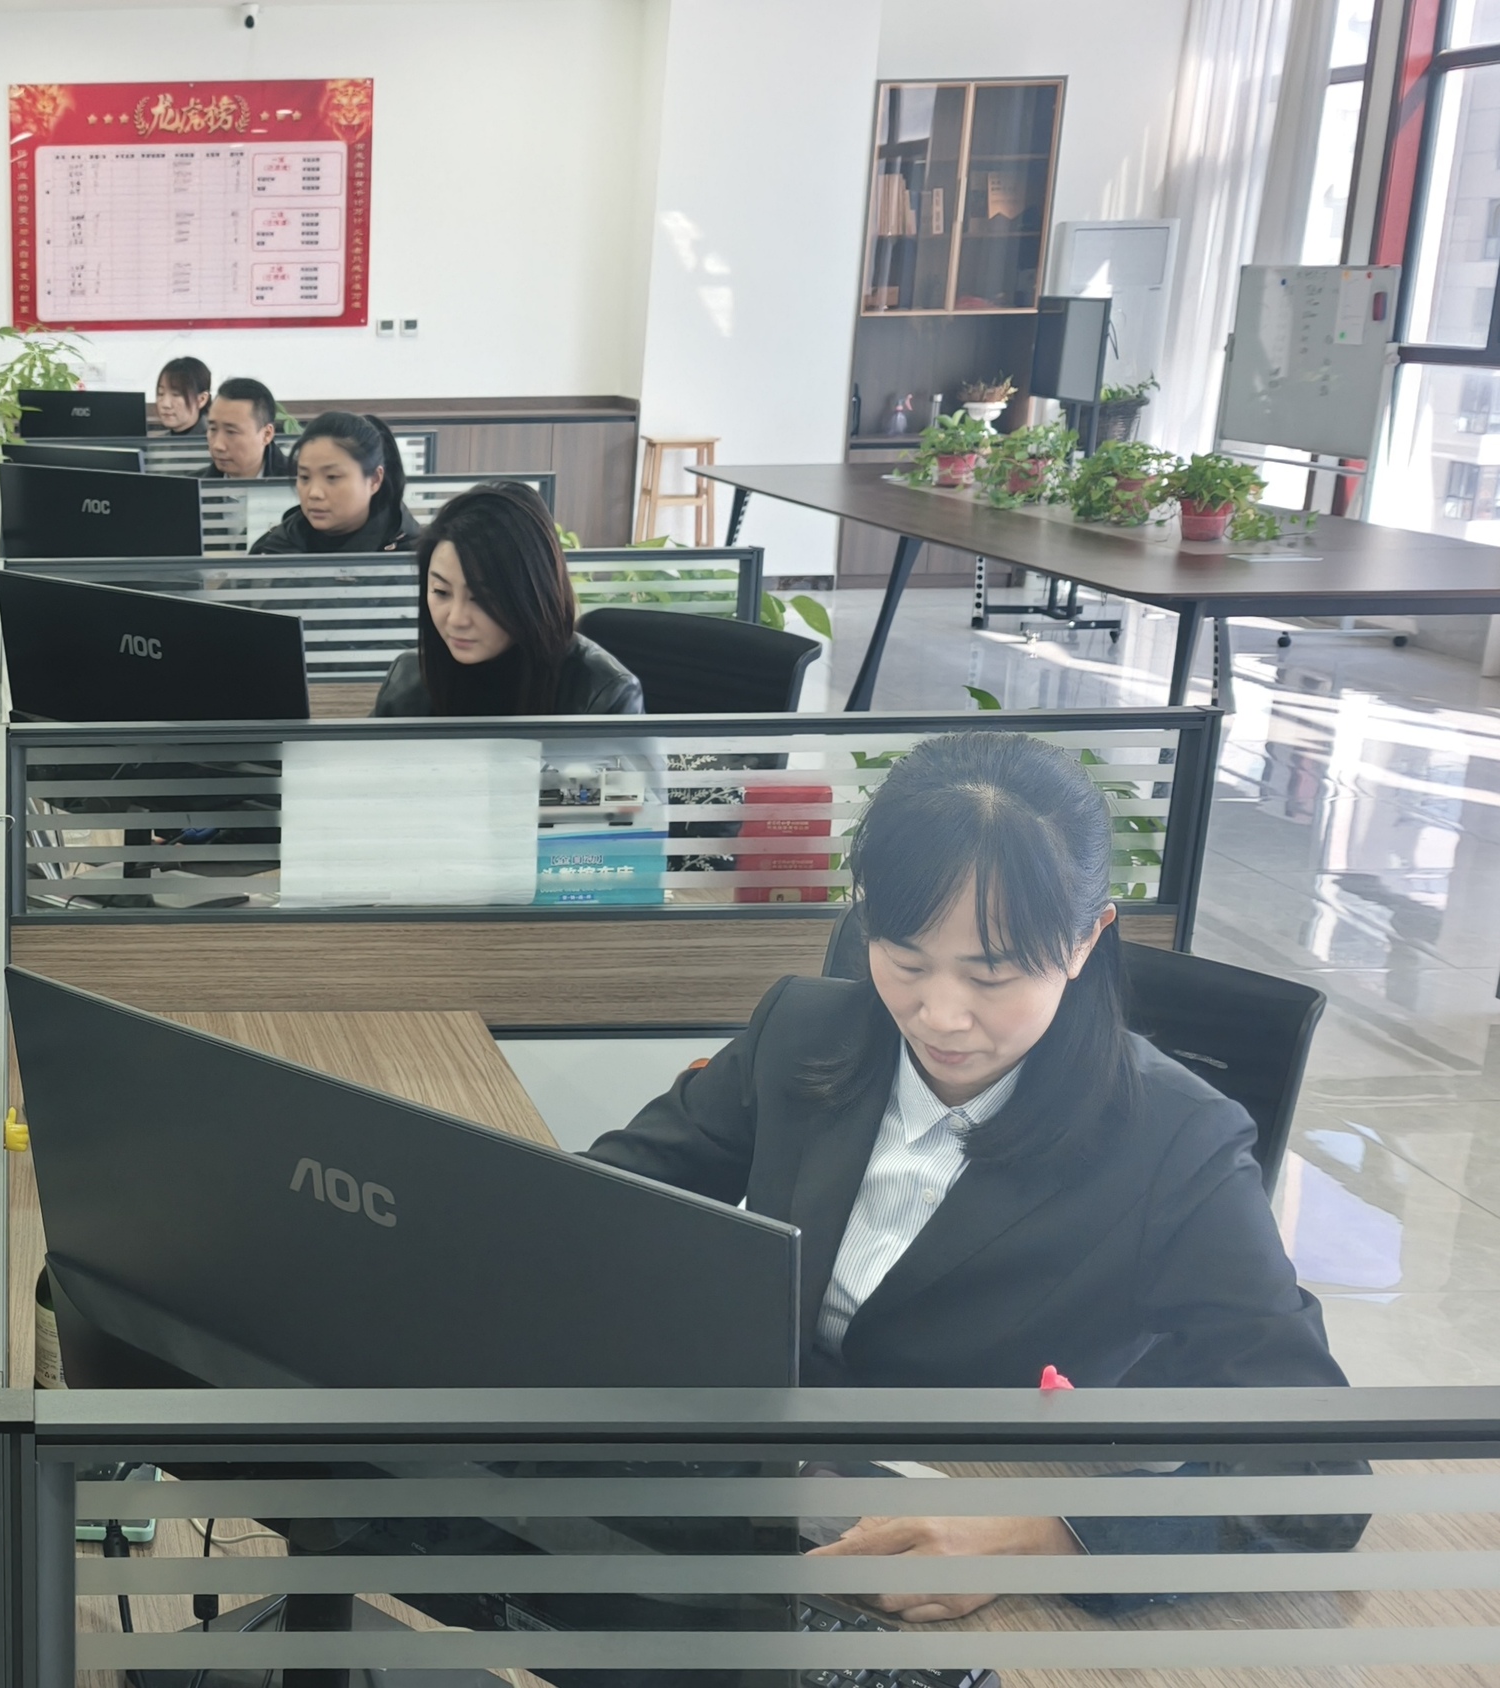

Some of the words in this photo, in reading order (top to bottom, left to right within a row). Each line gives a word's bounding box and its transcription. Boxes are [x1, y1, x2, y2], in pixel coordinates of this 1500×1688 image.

[145, 93, 237, 138] 龙虎榜
[71, 407, 91, 417] AOC
[81, 498, 111, 515] AOC
[119, 633, 163, 660] AOC
[289, 1157, 397, 1228] AOC
